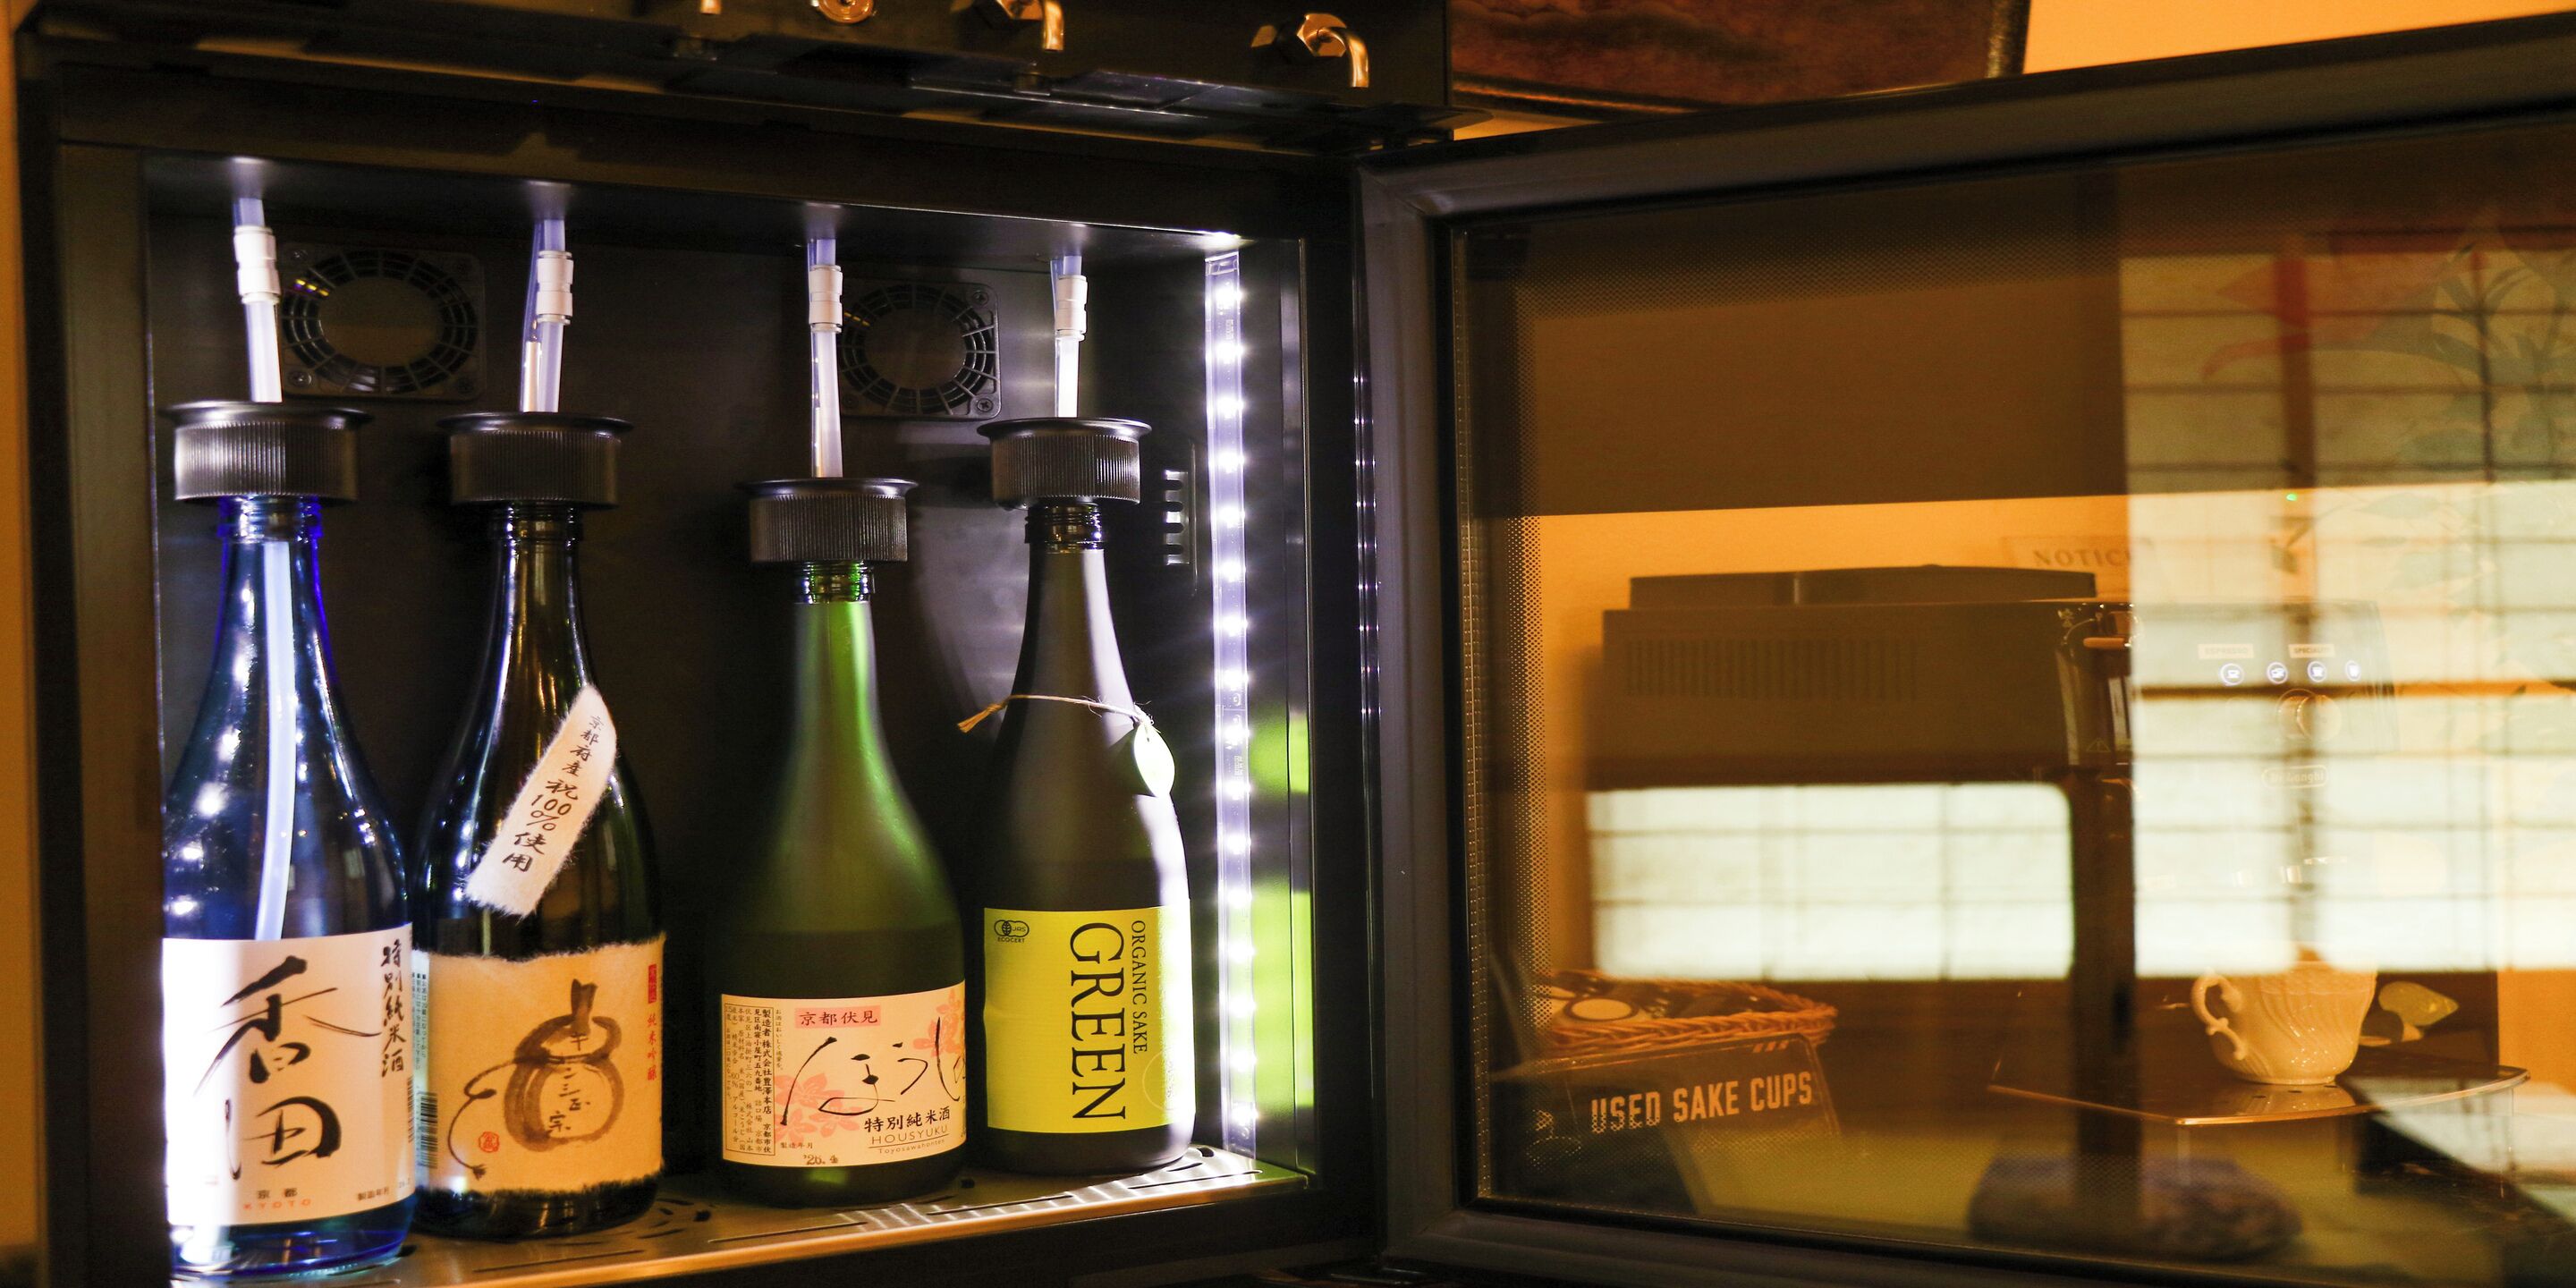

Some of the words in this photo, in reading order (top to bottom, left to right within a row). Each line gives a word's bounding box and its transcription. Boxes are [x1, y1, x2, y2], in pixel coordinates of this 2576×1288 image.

[2032, 547, 2130, 568] NOTIC
[1012, 925, 1027, 933] JAS
[1131, 919, 1148, 1005] ORGANIC
[380, 938, 407, 1078] 特別純米酒
[799, 1009, 878, 1027] 京都伏見
[1070, 922, 1126, 1120] GREEN
[762, 1008, 772, 1037] 製造者
[1132, 1011, 1148, 1055] SAKE
[1590, 1090, 1661, 1134] USED
[1674, 1080, 1740, 1123] SAKE
[1750, 1071, 1813, 1113] CUPS
[863, 1106, 951, 1133] 特別純米酒
[763, 1123, 772, 1153] 京都市伏
[871, 1124, 949, 1145] HOUSYUKU
[242, 1198, 312, 1210] KYOTO
[257, 1187, 299, 1200] 京都
